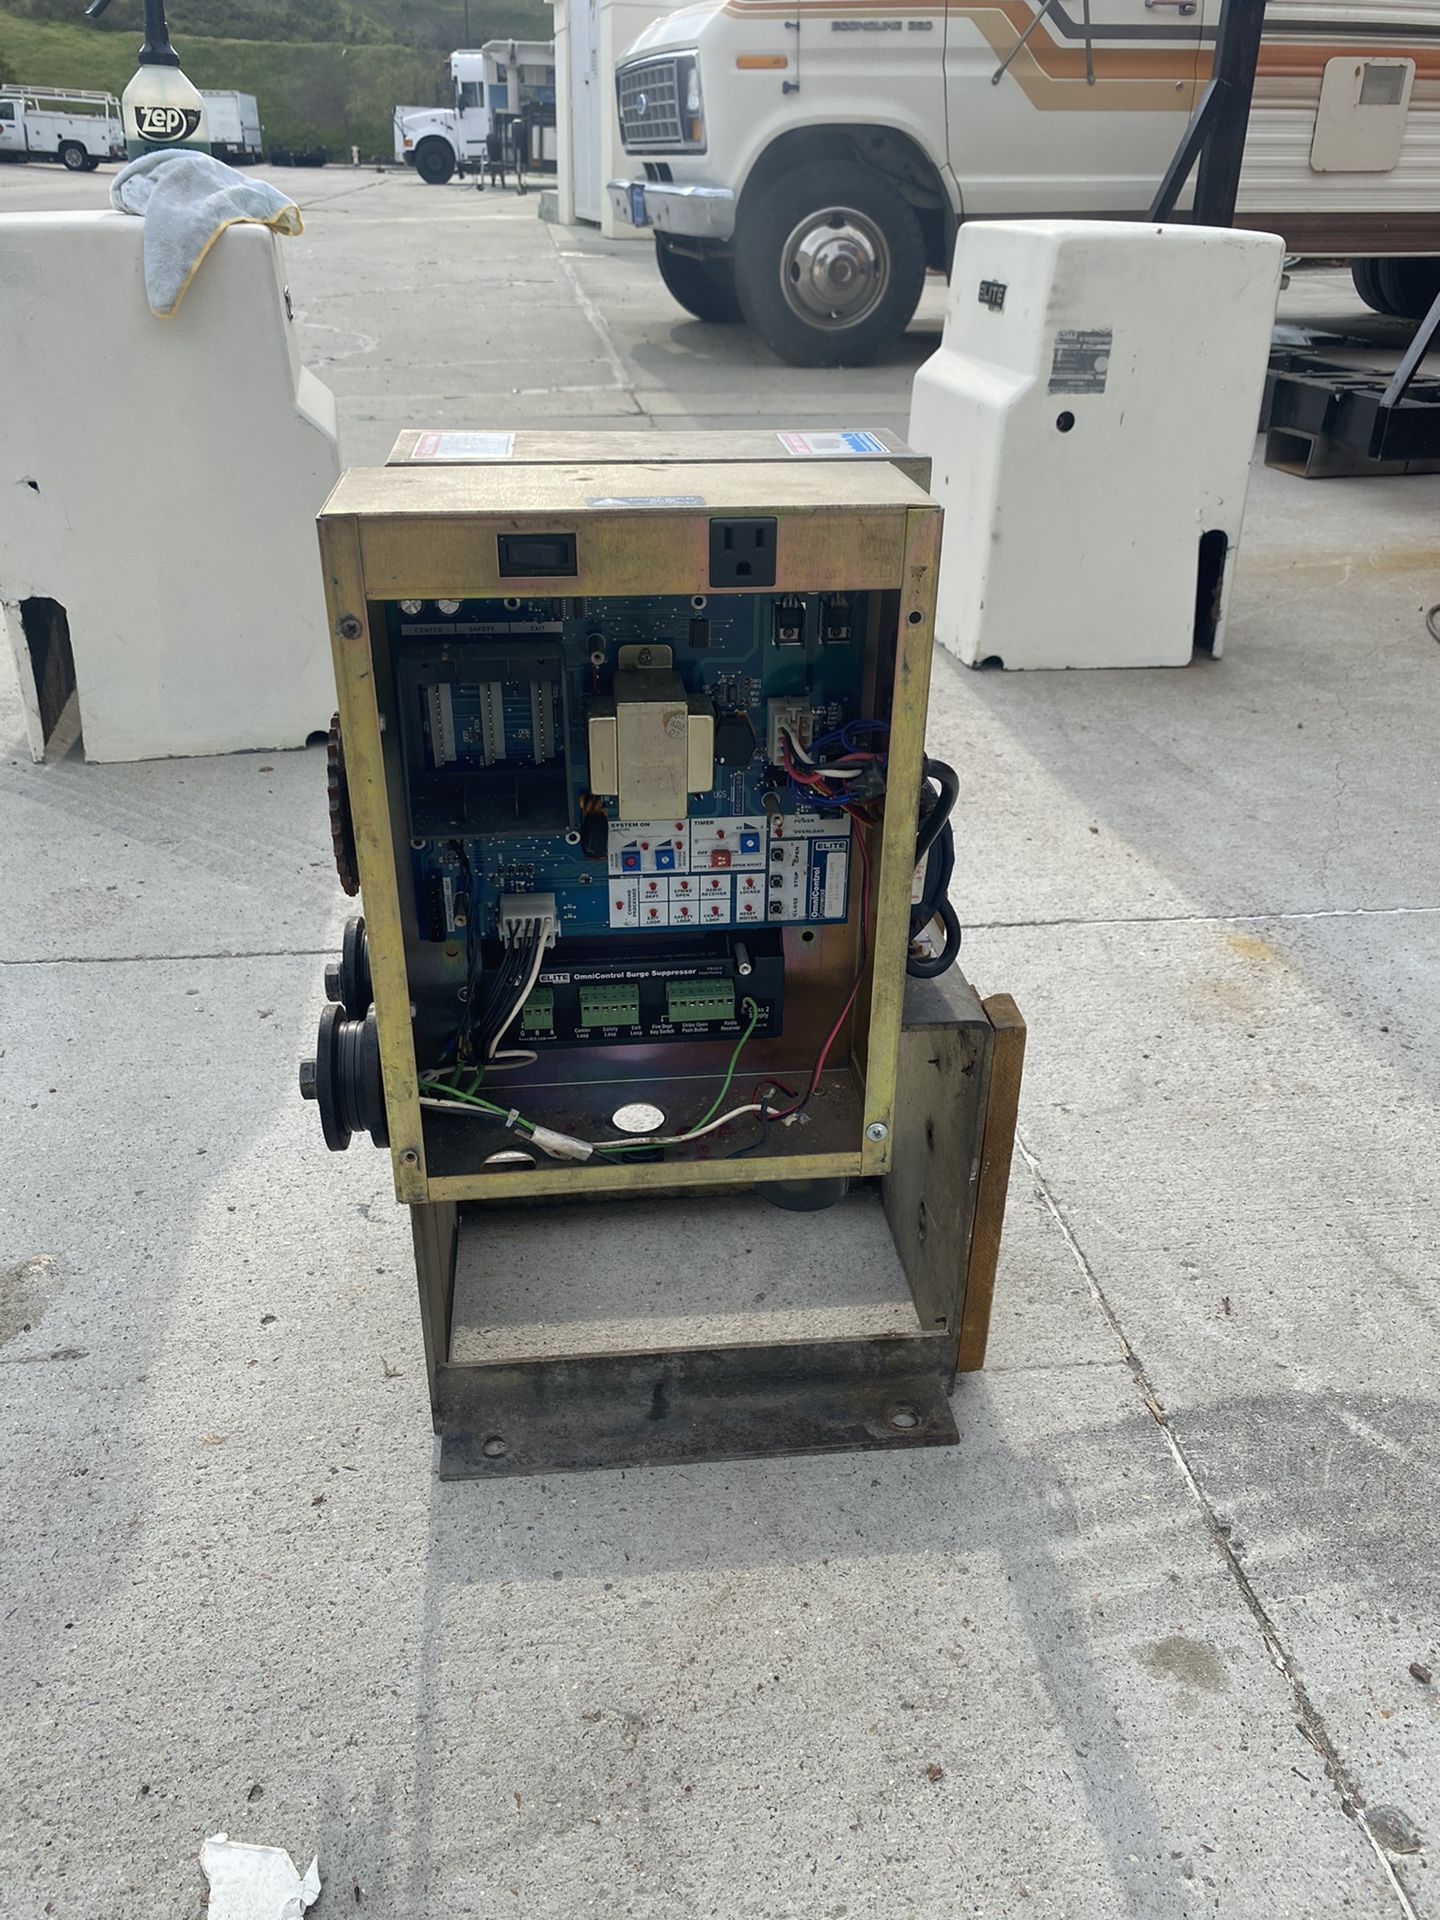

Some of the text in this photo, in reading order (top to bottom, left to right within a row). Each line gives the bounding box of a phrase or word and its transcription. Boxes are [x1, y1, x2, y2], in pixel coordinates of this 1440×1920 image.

[978, 283, 1005, 303] ELITE
[468, 625, 495, 633] SAFETY
[811, 866, 821, 918] OmniControl
[573, 971, 624, 980] OmniControl
[626, 971, 650, 980] Surge
[651, 968, 697, 978] Suppressor
